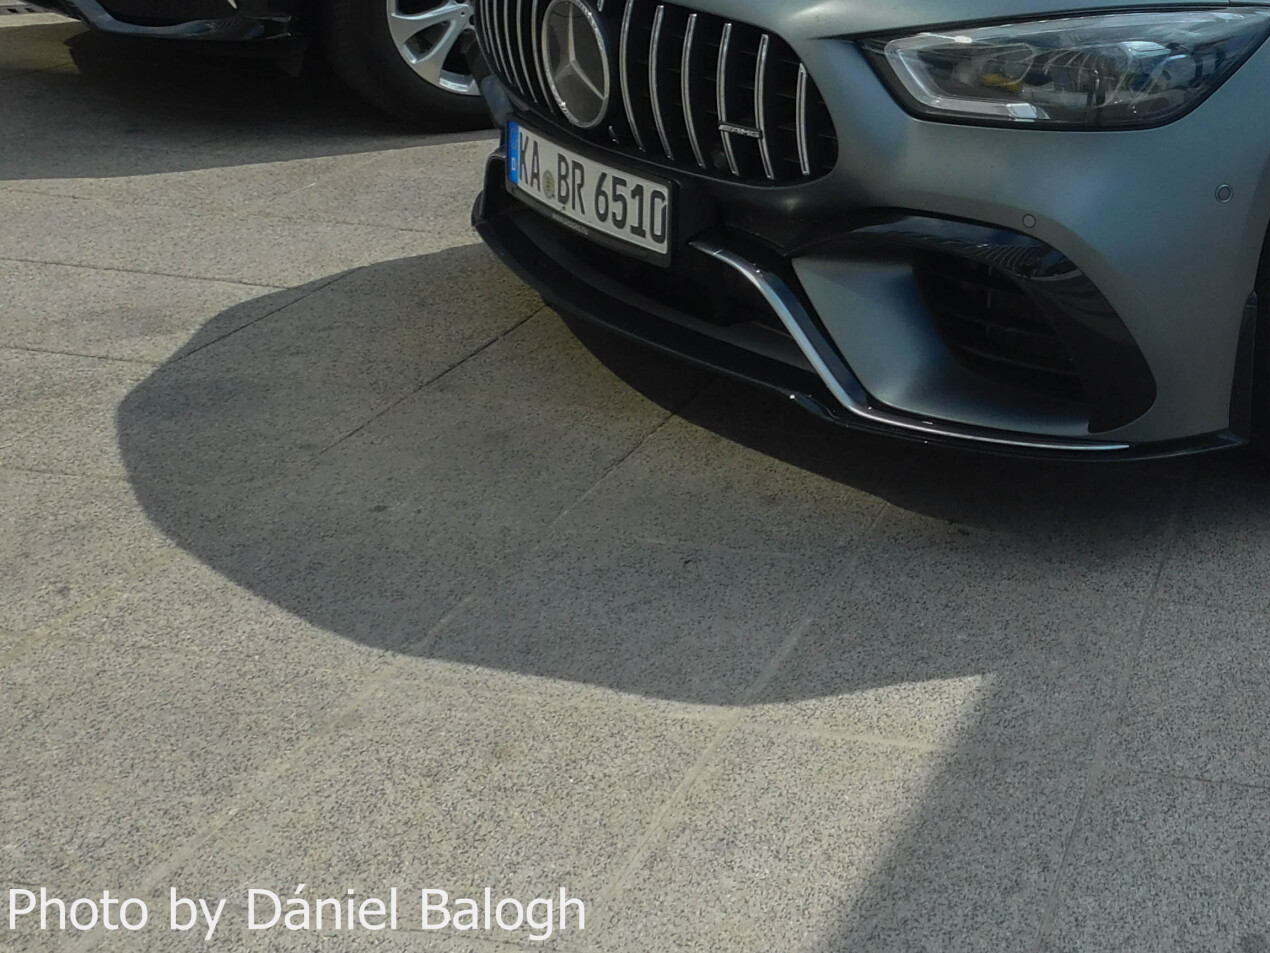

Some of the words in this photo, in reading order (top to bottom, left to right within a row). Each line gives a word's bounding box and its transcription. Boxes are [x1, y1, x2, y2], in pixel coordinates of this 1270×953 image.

[519, 131, 541, 193] KA
[557, 153, 586, 216] BR
[594, 171, 668, 245] 6510
